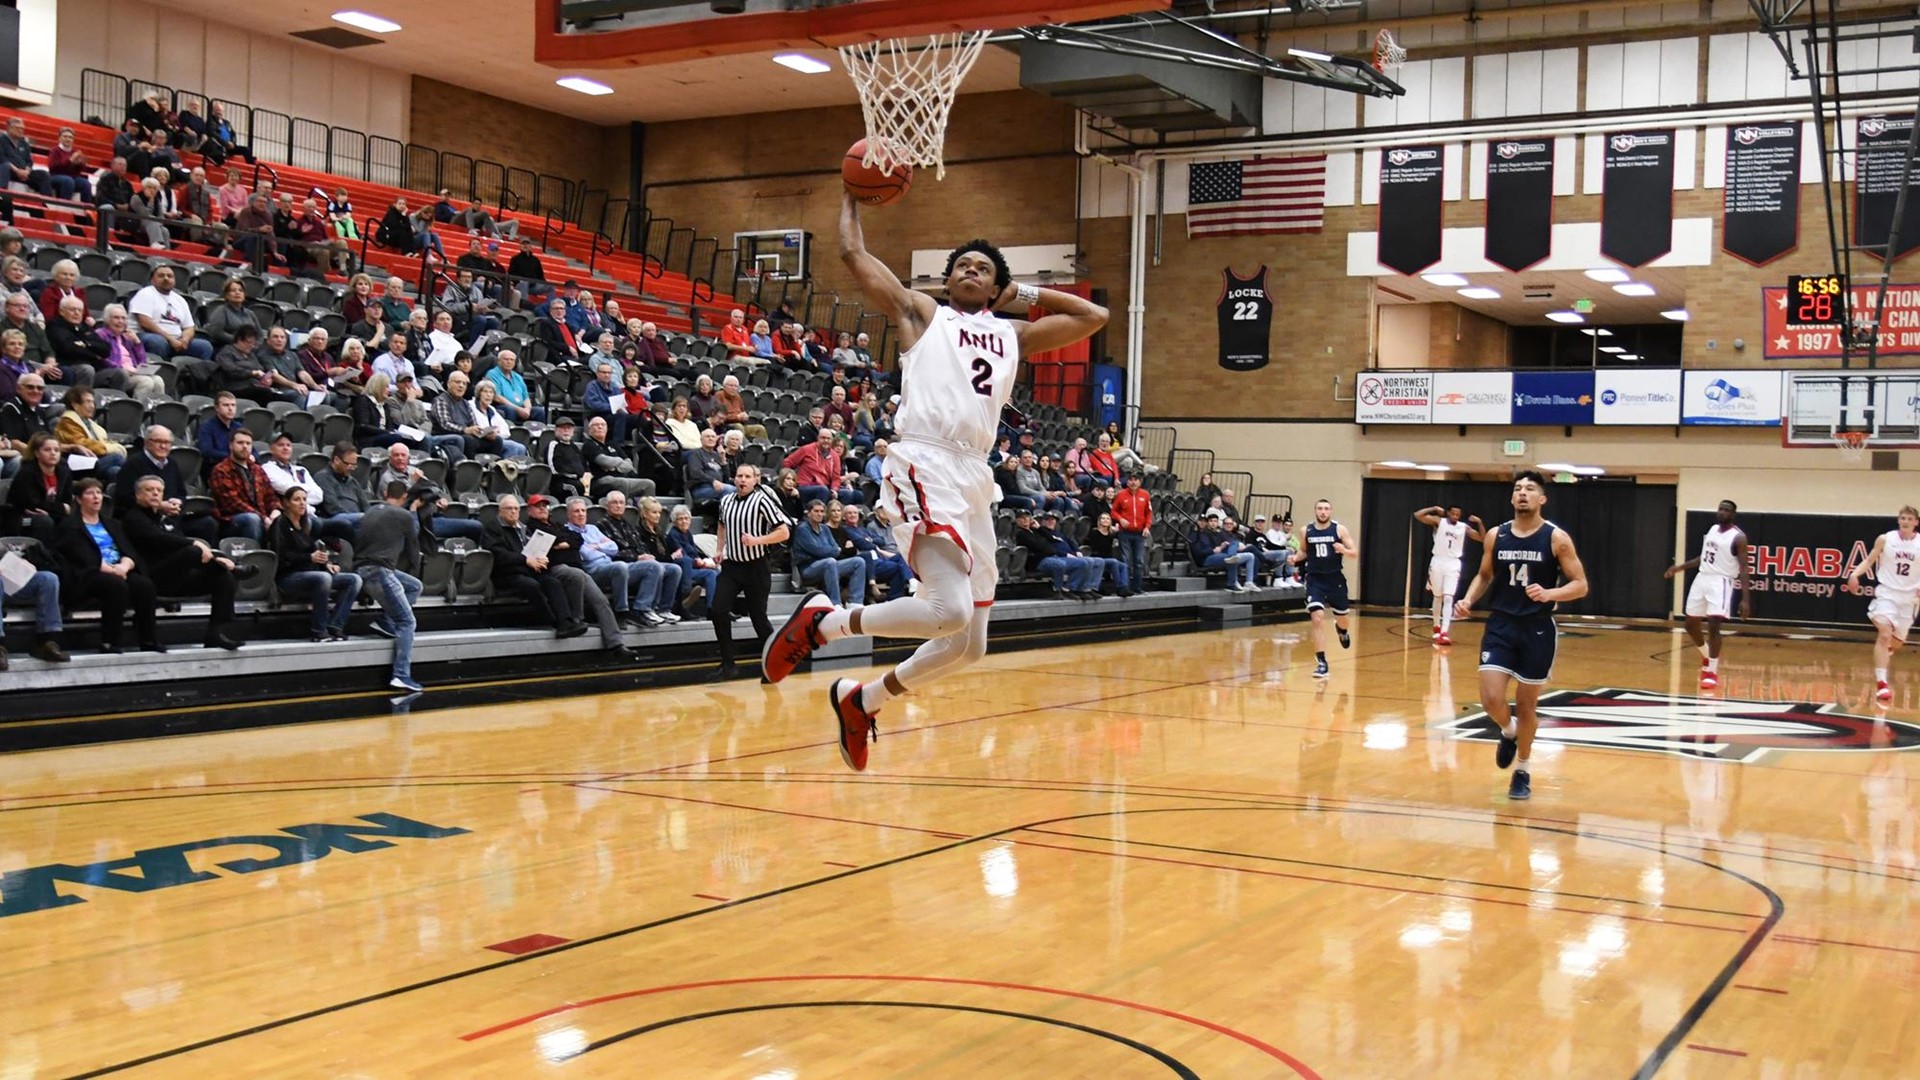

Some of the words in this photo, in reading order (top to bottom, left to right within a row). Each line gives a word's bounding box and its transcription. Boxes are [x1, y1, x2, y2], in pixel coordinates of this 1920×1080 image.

[1228, 288, 1264, 299] LOCKE
[1798, 278, 1840, 294] 16:56
[1233, 301, 1259, 320] 22
[1799, 295, 1832, 320] 28
[959, 328, 1004, 358] NNU
[1797, 333, 1832, 350] 1997
[971, 357, 993, 397] 2
[1383, 378, 1429, 387] NORTHWEST
[1383, 388, 1429, 397] CHRISTIAN
[1738, 402, 1756, 410] Plus
[1307, 535, 1335, 544] CONCORDIA
[1315, 543, 1328, 558] 10
[1498, 550, 1542, 561] CONCORDIA
[1895, 551, 1915, 561] NNU
[1509, 563, 1528, 587] 14
[1896, 562, 1911, 576] 12
[1773, 578, 1835, 598] therapy
